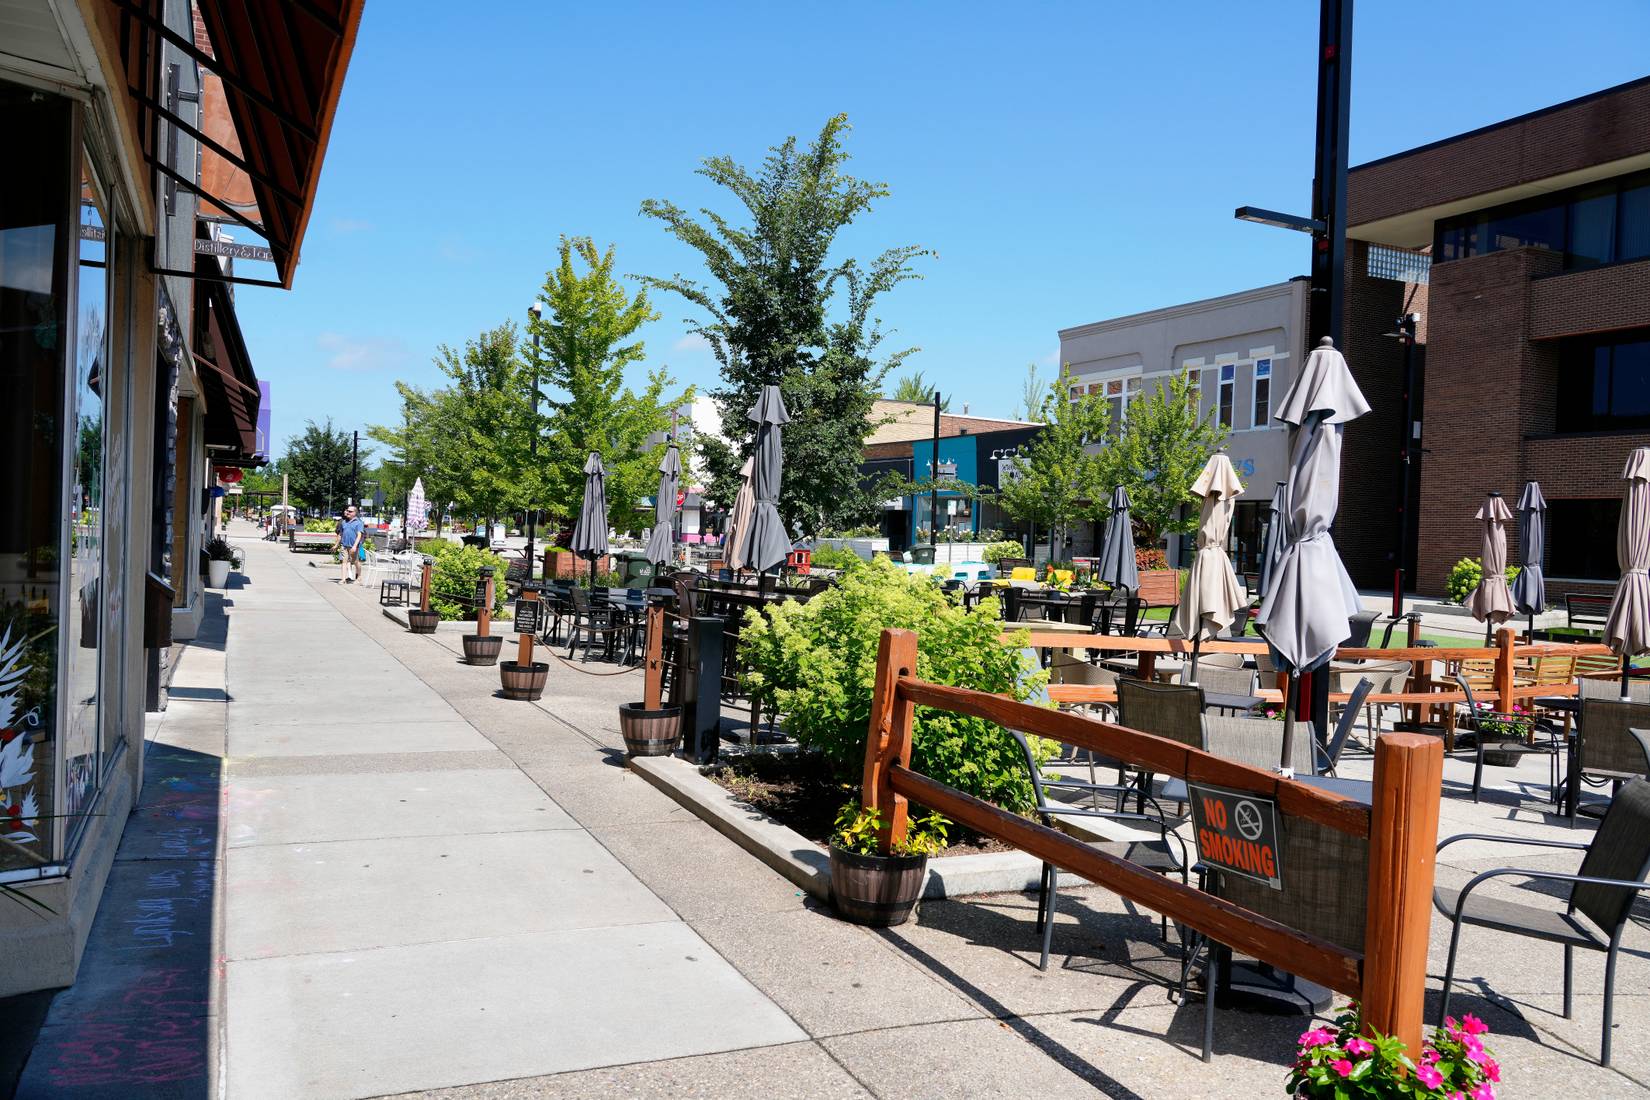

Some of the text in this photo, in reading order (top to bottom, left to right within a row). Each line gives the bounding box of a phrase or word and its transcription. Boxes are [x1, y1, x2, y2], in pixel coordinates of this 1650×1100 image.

[195, 239, 240, 256] Distillery
[240, 245, 252, 258] &
[1203, 797, 1227, 830] NO
[1199, 828, 1275, 877] SMOKING
